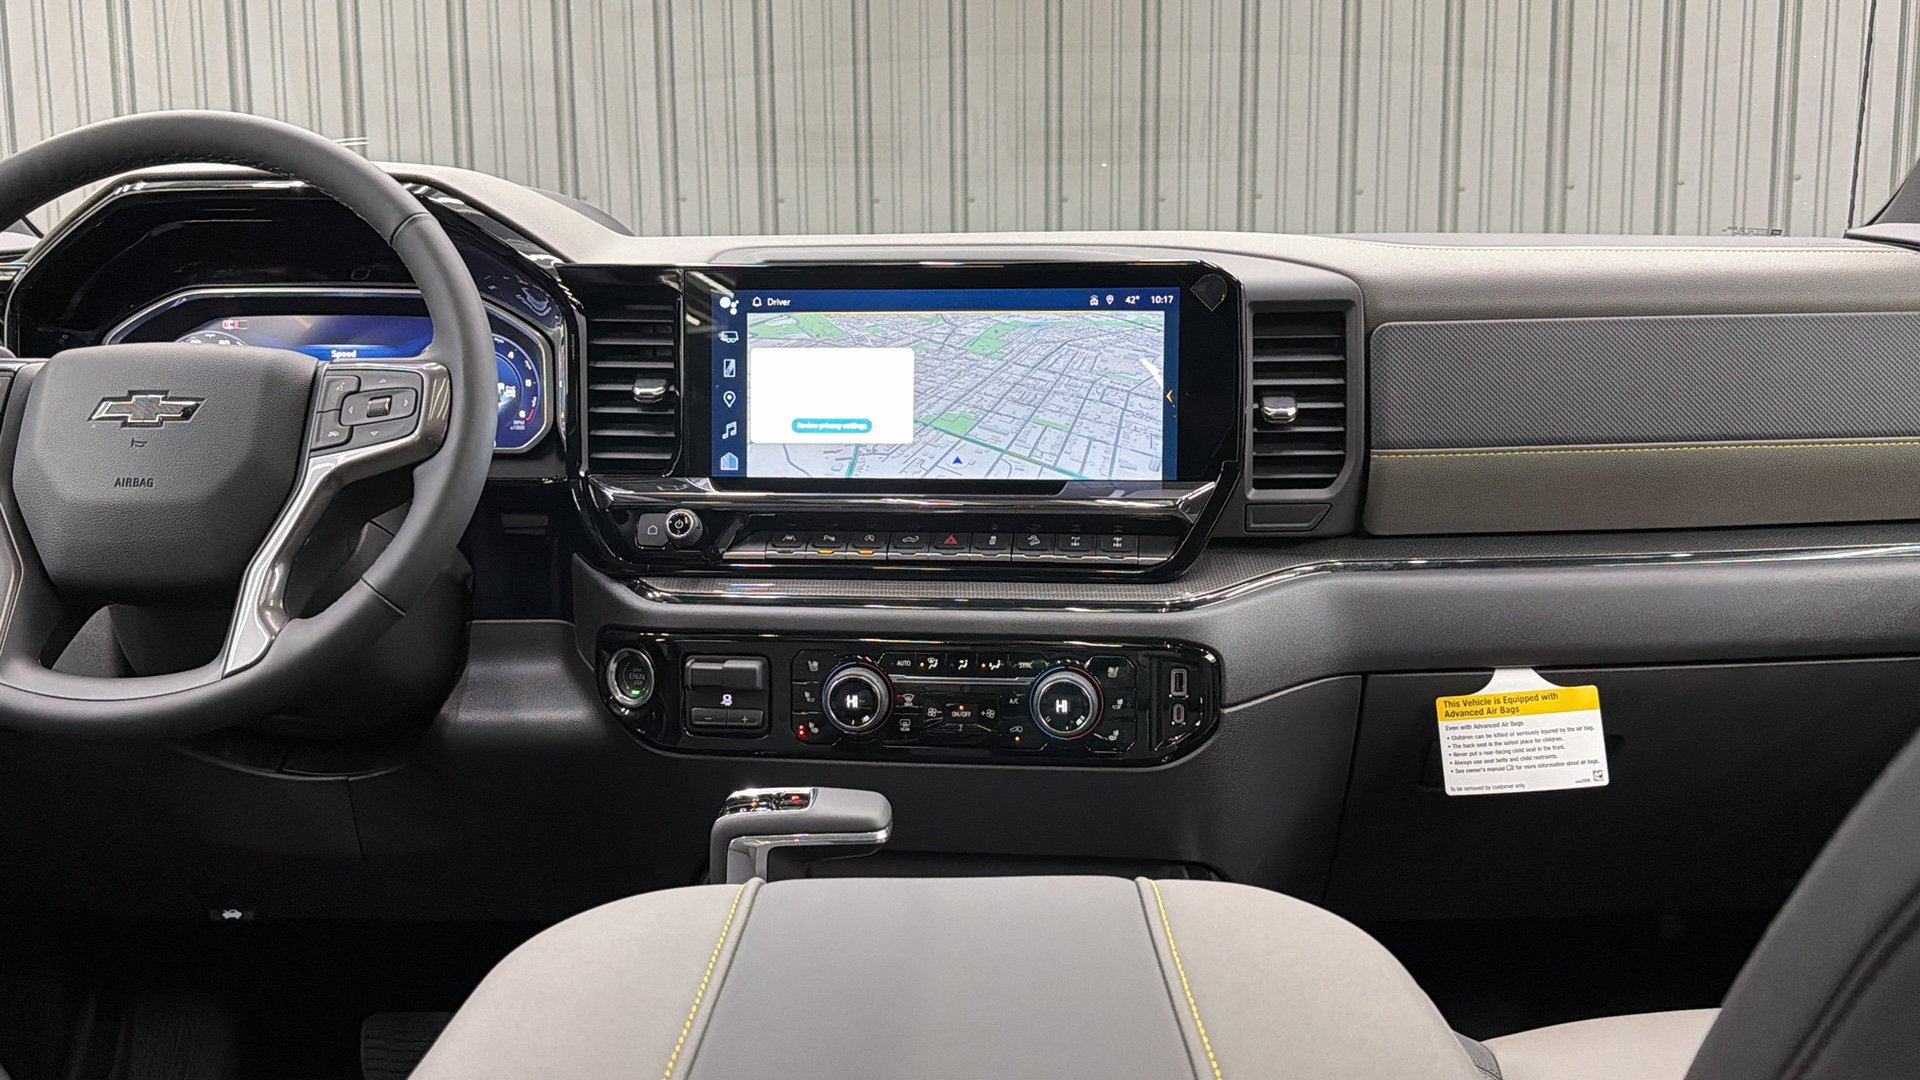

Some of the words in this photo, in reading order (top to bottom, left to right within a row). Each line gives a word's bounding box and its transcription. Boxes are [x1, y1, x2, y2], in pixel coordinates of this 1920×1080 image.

[767, 298, 791, 306] Driver
[1151, 295, 1174, 304] 10:17
[331, 350, 357, 358] Speed
[508, 351, 514, 359] 4
[114, 478, 154, 487] AIRBAG
[846, 694, 859, 708] HI
[1462, 698, 1492, 707] Vehicle
[1503, 694, 1539, 705] Equipped
[1541, 692, 1558, 701] with
[1056, 700, 1068, 714] HI
[1444, 708, 1484, 718] Advanced
